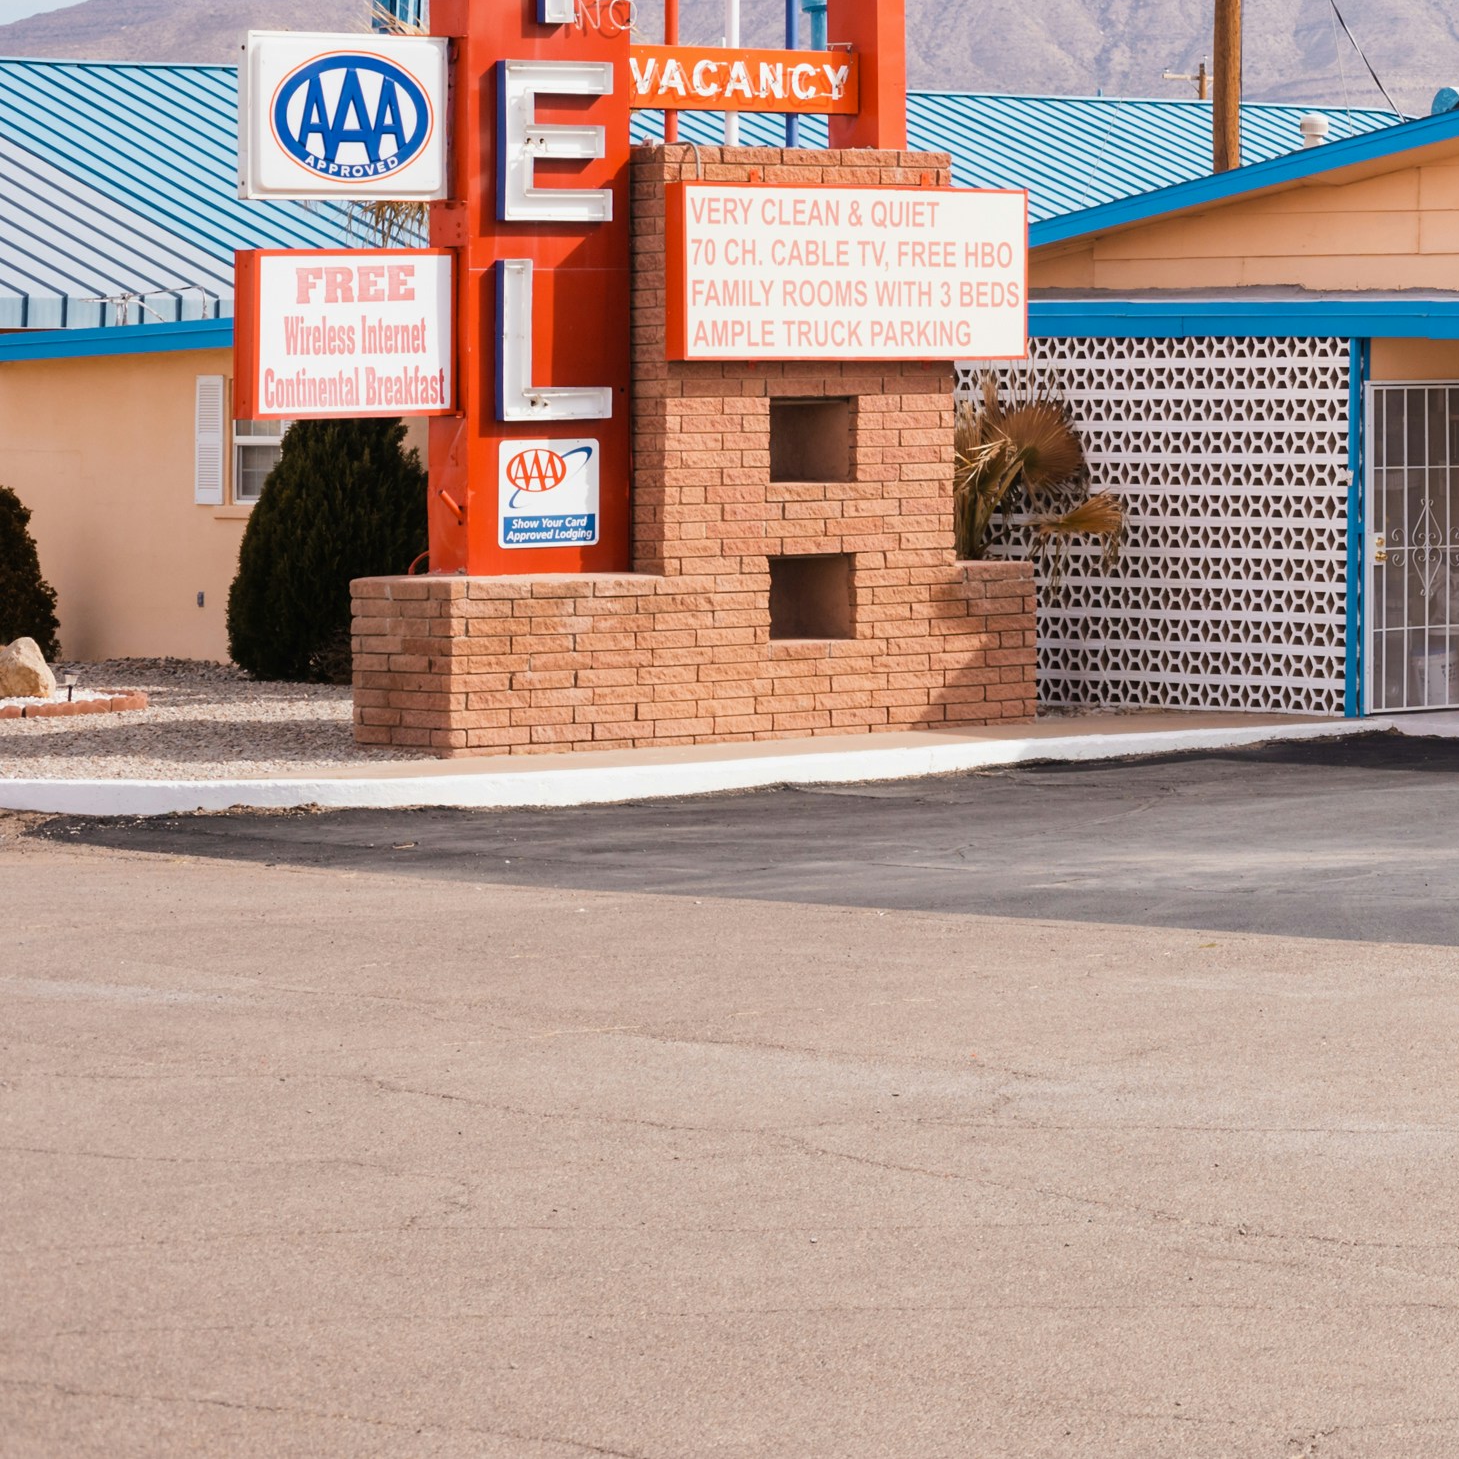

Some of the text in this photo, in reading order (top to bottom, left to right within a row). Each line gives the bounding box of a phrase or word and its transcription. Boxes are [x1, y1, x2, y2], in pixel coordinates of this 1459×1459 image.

[629, 57, 849, 100] VACANCY
[297, 67, 408, 164] AAA
[304, 155, 399, 178] APPROVED
[690, 197, 939, 230] VERY CLEAN & QUIET
[691, 238, 1013, 272] 70 CH. CABLE TV, FREE HBO
[296, 264, 415, 304] FREE
[692, 279, 1020, 308] FAMILY ROOMS WITH 3 BEDS
[283, 315, 427, 356] Wireless Internet
[693, 320, 972, 347] AMPLE TRUCK PARKING
[264, 365, 445, 409] Continental Breakfast
[512, 449, 561, 491] AAA
[506, 527, 592, 543] Approved Lodging
[511, 516, 588, 529] Show Your Card
